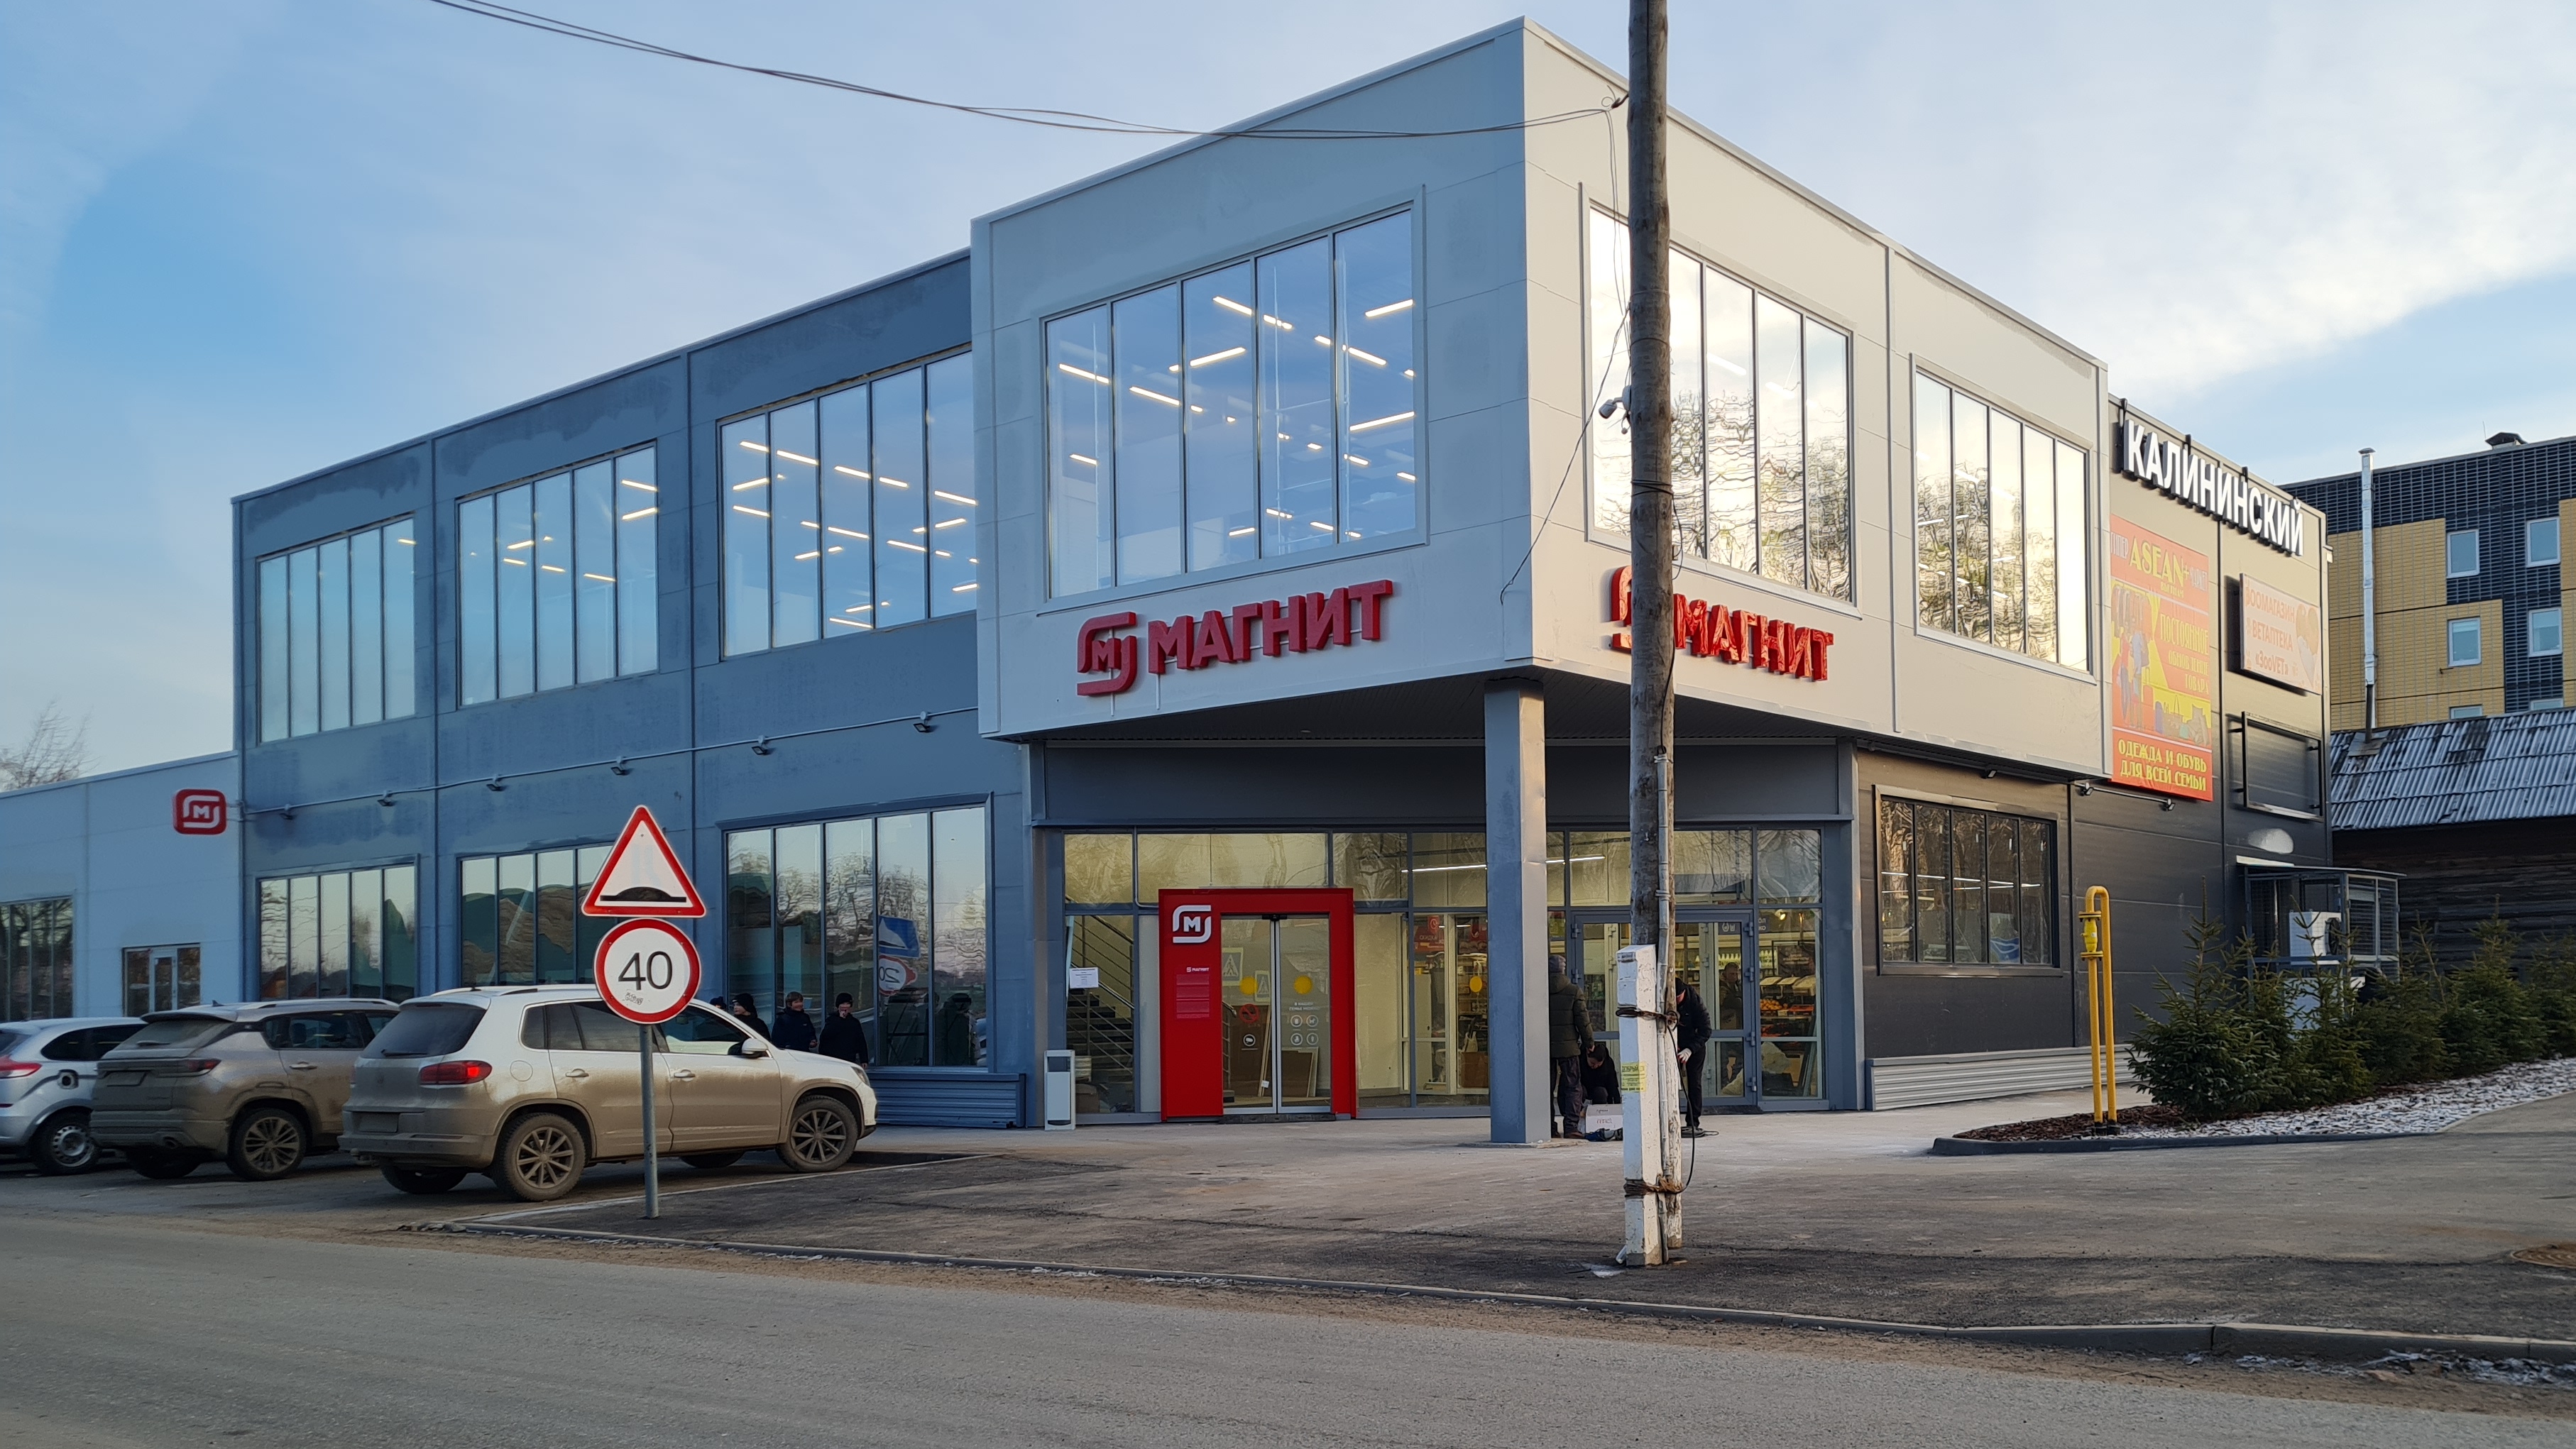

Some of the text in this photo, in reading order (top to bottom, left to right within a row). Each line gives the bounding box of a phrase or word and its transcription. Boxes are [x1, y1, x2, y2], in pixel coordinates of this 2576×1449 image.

[2123, 419, 2303, 556] КАЛИНИНСКИЙ
[2246, 587, 2296, 624] ЗООМАГАЗИН
[1148, 579, 1394, 674] МАГНИТ
[1672, 593, 1834, 682] МАГНИТ
[2160, 613, 2209, 656] ПОСТОЯННОЕ
[2252, 619, 2293, 651] ВЕТАПТЕКА
[2118, 739, 2207, 773] ОДЕЖДА И ОБУВЬ
[2120, 759, 2207, 791] ДЛЯ ВСЕЙ СЕМЬИ
[618, 951, 673, 991] 40
